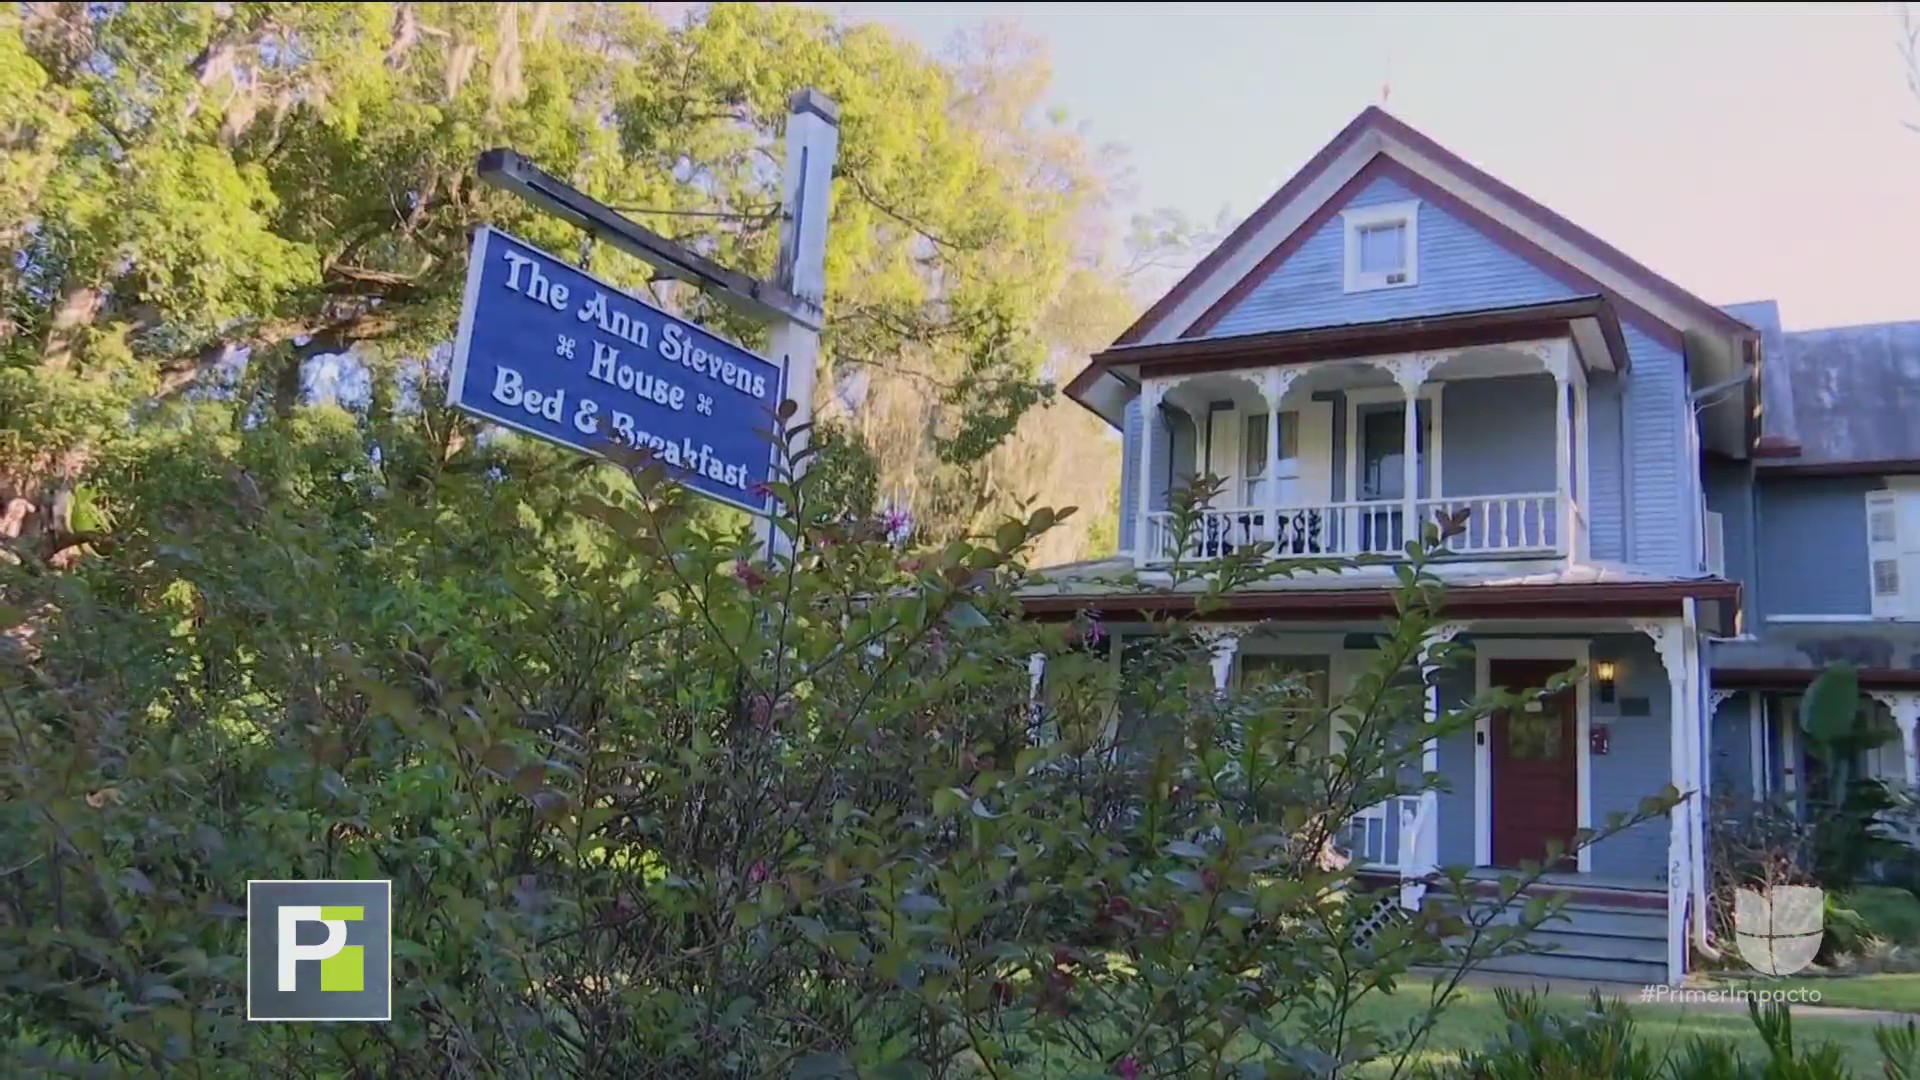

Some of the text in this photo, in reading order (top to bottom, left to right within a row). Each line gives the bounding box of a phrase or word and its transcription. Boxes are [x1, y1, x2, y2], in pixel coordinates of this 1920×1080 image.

[504, 251, 766, 398] The Ann Stevens
[492, 366, 564, 422] Bed
[573, 399, 599, 435] &
[588, 340, 685, 411] House
